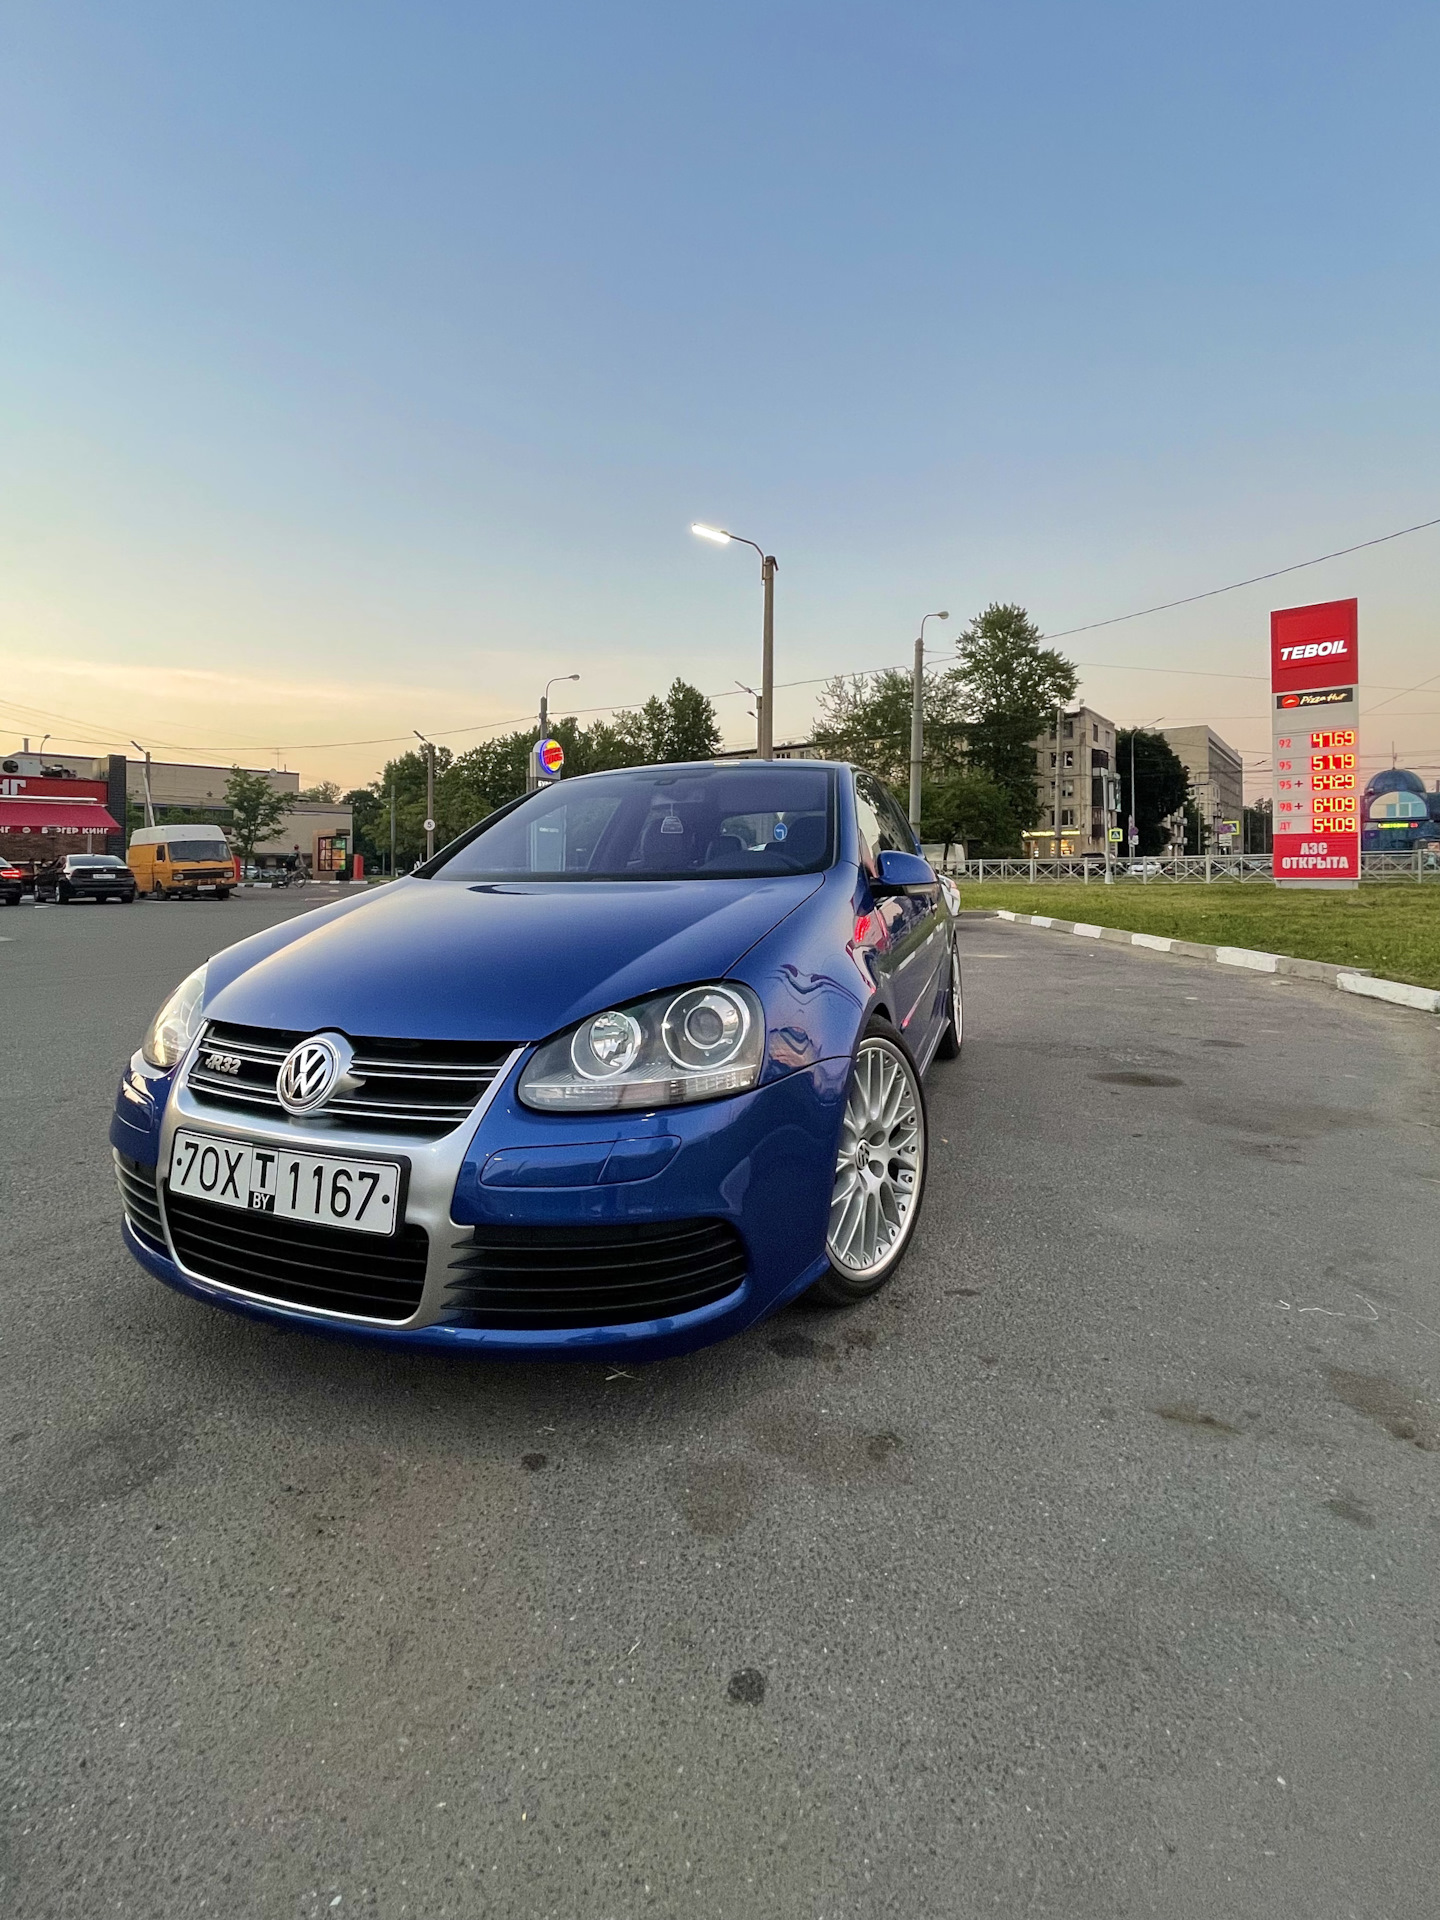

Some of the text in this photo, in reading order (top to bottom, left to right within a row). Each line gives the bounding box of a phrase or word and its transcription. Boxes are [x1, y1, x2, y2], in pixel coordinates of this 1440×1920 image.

[1280, 640, 1348, 661] TEBOIL
[1300, 692, 1348, 705] Pizza Hut
[1278, 730, 1355, 748] 92 47.69
[1278, 753, 1355, 771] 95 51.79
[1279, 780, 1292, 790] 95
[1312, 774, 1355, 791] 54.29
[1279, 802, 1292, 812] 98
[1313, 797, 1356, 813] 64.09
[82, 827, 109, 835] КИНГ
[1279, 817, 1356, 833] ДТ 54.09
[1300, 842, 1328, 855] АЗС
[1281, 850, 1349, 870] ОТКРЫТА
[209, 1054, 241, 1075] R32
[288, 1161, 381, 1222] 1167
[252, 1192, 270, 1210] BY
